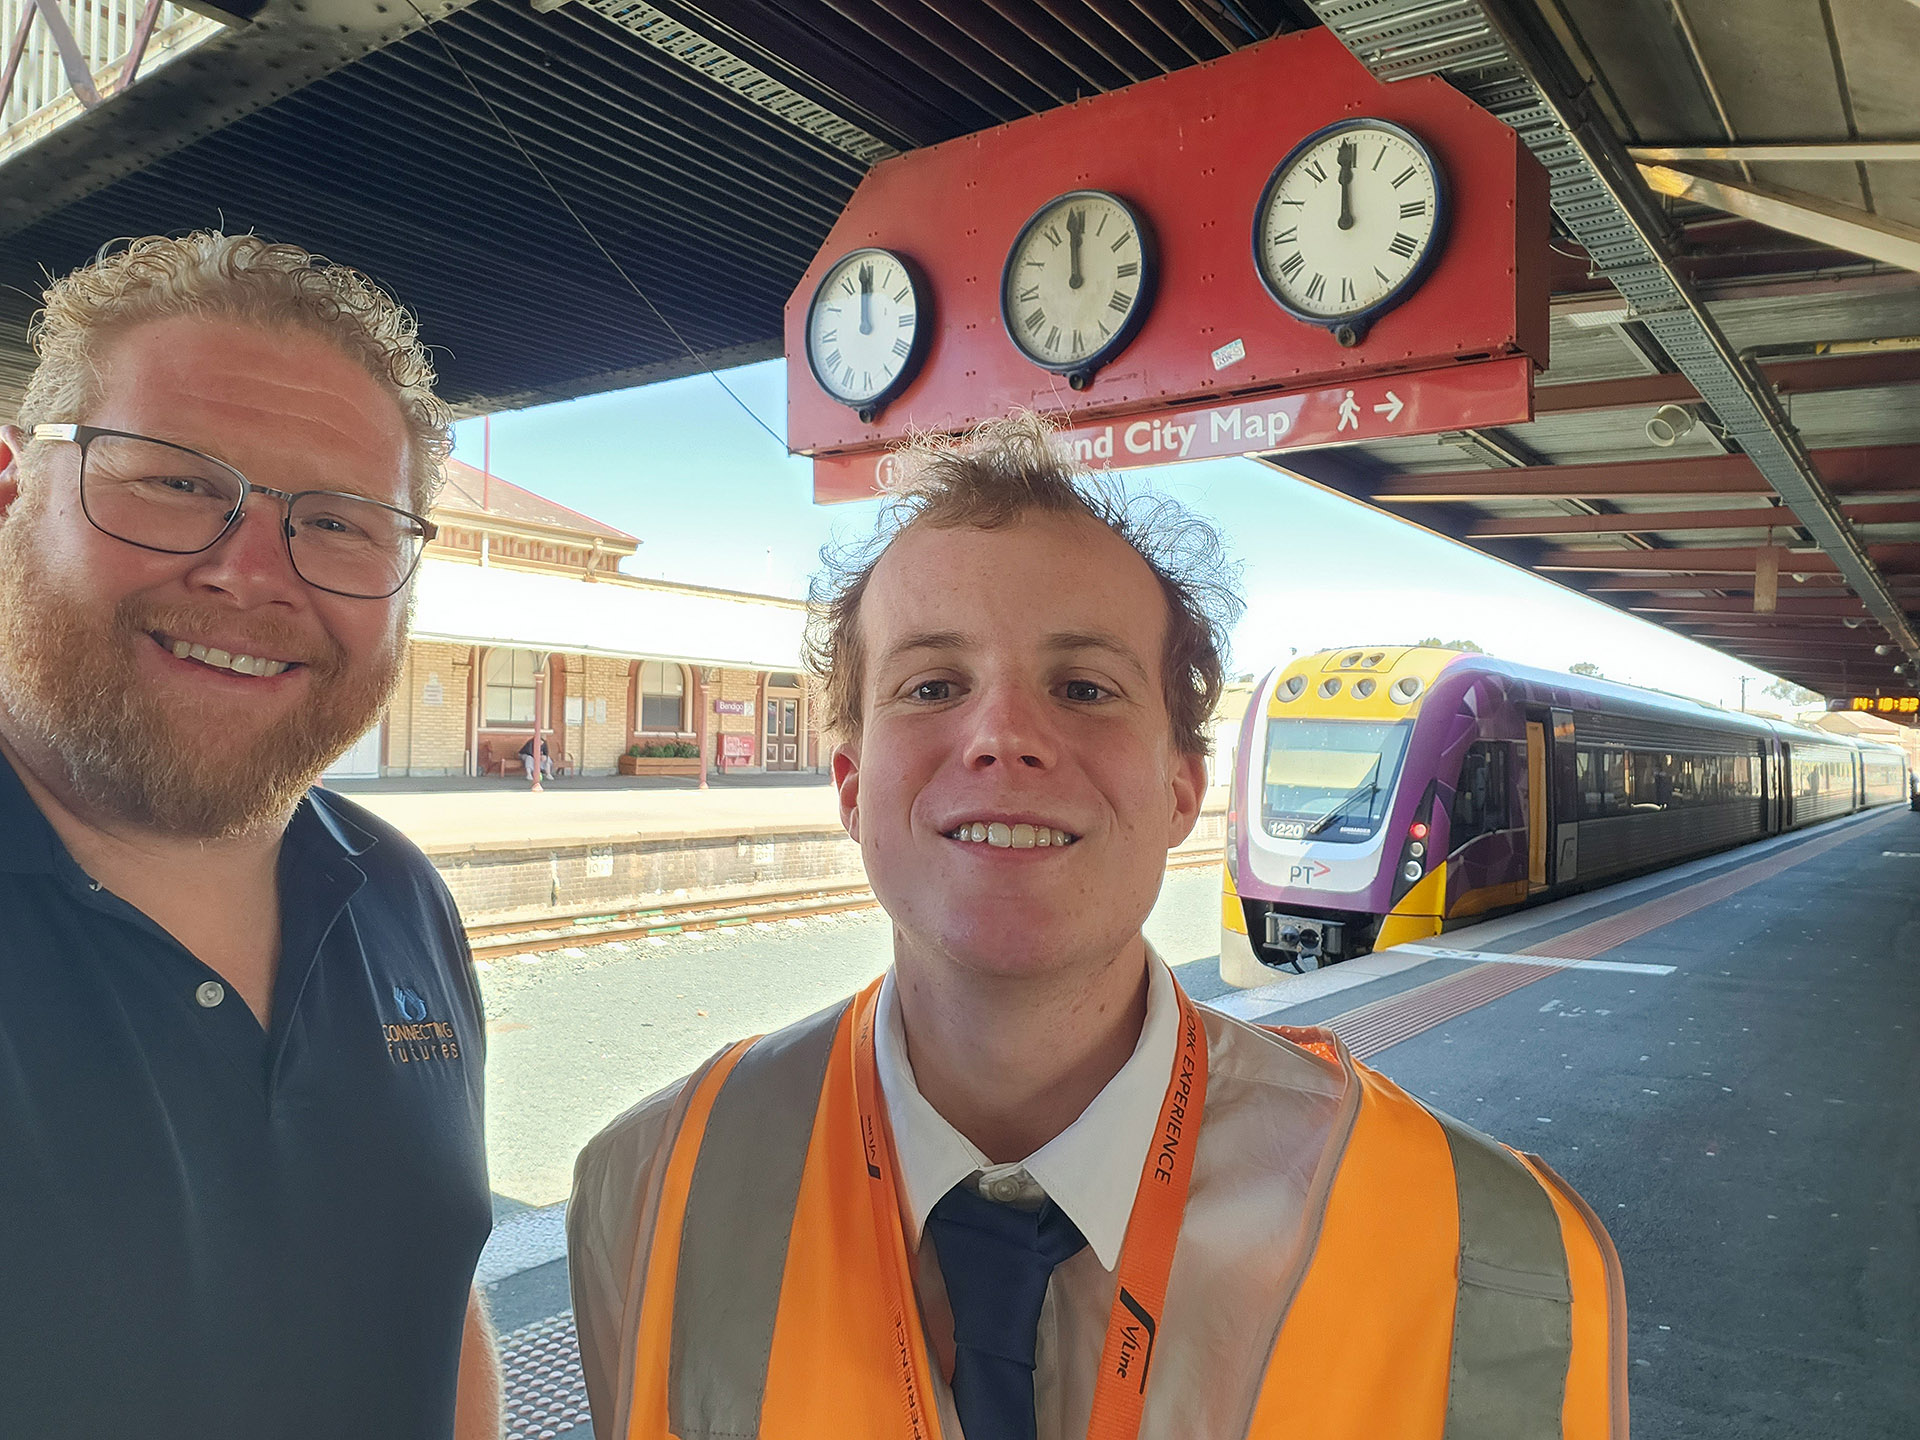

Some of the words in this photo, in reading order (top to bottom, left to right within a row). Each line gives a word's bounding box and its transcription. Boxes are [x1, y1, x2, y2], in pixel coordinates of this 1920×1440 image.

[1123, 419, 1197, 457] City
[1209, 407, 1291, 448] Map
[719, 701, 744, 712] Bendigo
[1270, 822, 1303, 837] 1220
[1290, 865, 1314, 884] PT
[382, 1021, 454, 1042] CONNECTING
[387, 1042, 459, 1065] futures
[1154, 1054, 1196, 1185] EXPERIENCE
